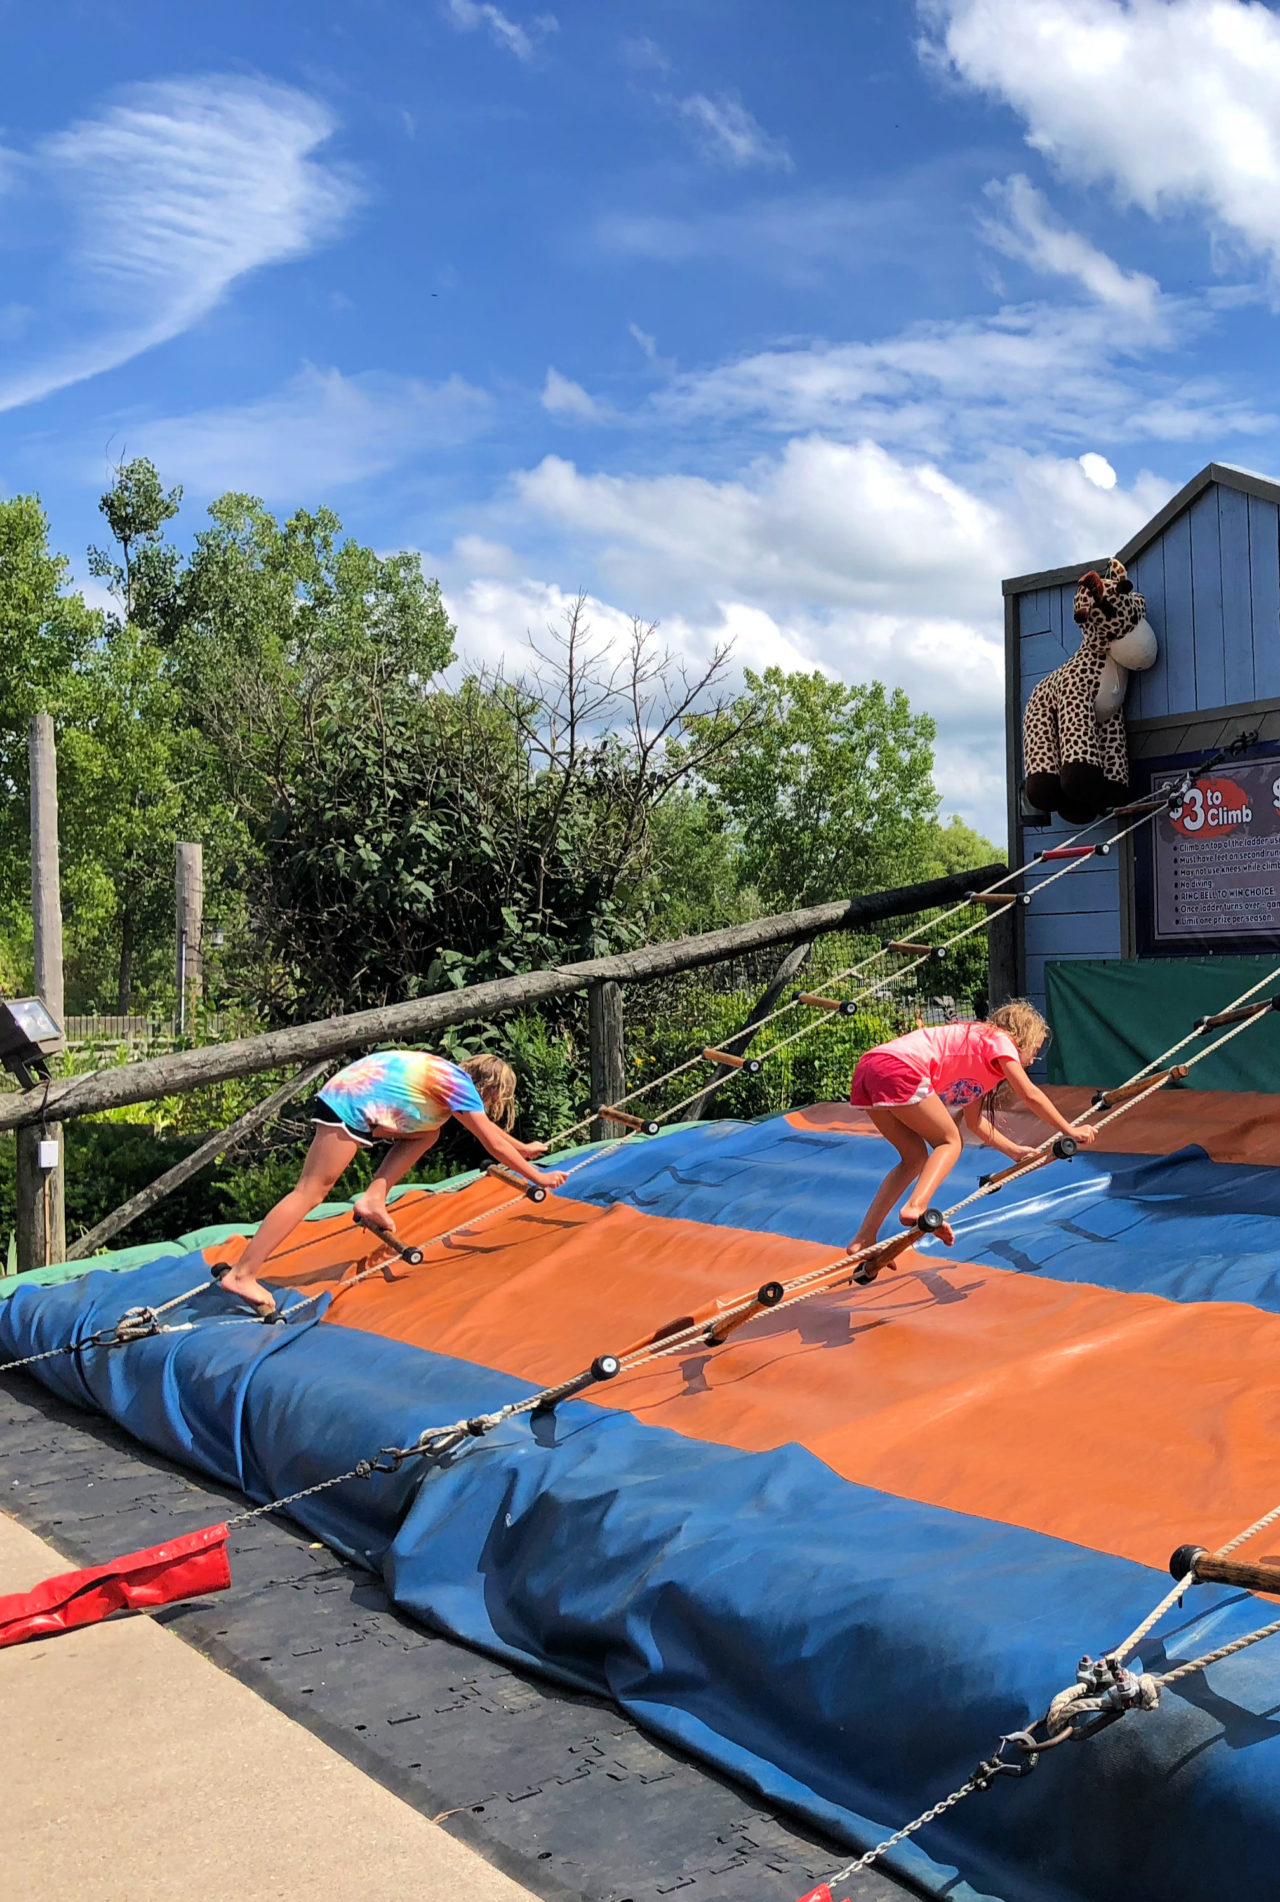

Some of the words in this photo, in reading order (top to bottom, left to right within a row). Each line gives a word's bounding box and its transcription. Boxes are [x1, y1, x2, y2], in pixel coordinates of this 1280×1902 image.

[1207, 789, 1223, 806] to
[1211, 842, 1222, 851] top
[1244, 836, 1268, 847] ladder
